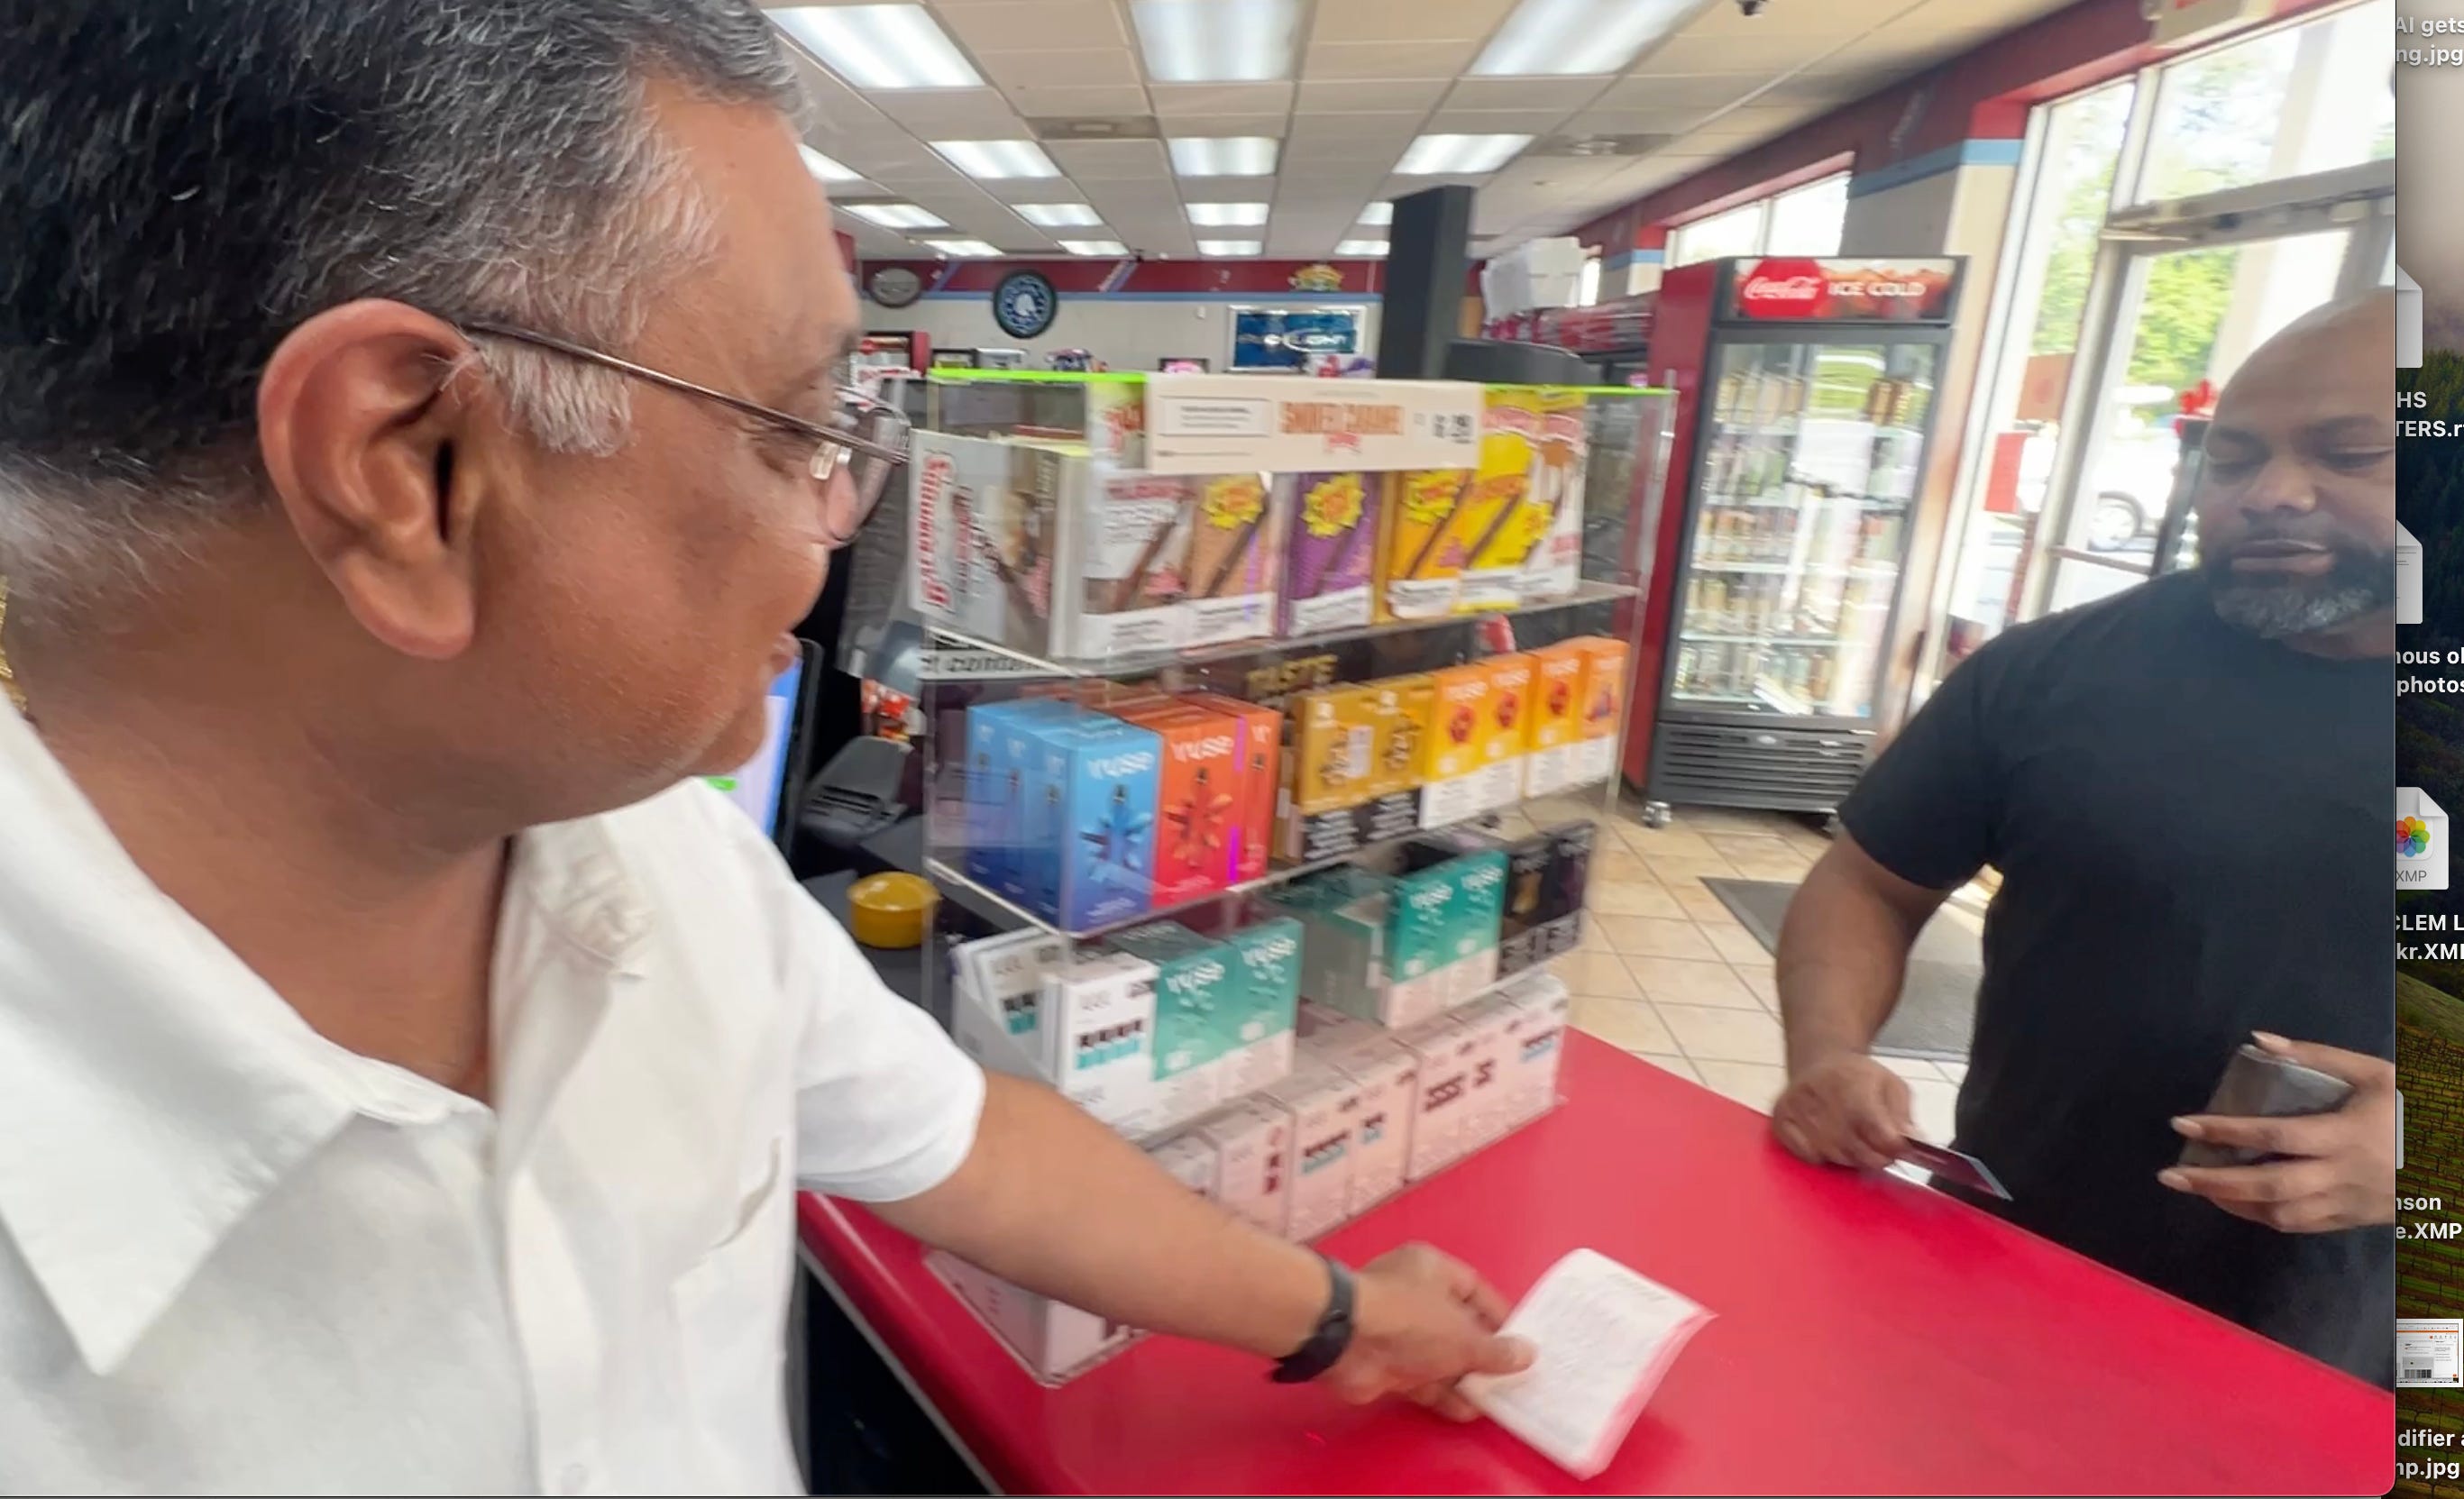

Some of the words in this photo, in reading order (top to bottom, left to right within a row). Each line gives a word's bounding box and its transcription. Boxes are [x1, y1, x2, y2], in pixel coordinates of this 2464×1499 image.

[2395, 17, 2414, 32] AI
[2421, 17, 2464, 37] gets
[1827, 281, 1865, 297] ICE
[1865, 281, 1927, 297] COLD
[2396, 391, 2427, 408] HS
[2395, 420, 2464, 437] TERS.r
[2396, 870, 2428, 882] XMP
[2396, 943, 2464, 960] kr.XM
[2395, 1222, 2463, 1240] e.XMP
[2398, 1429, 2454, 1447] difier
